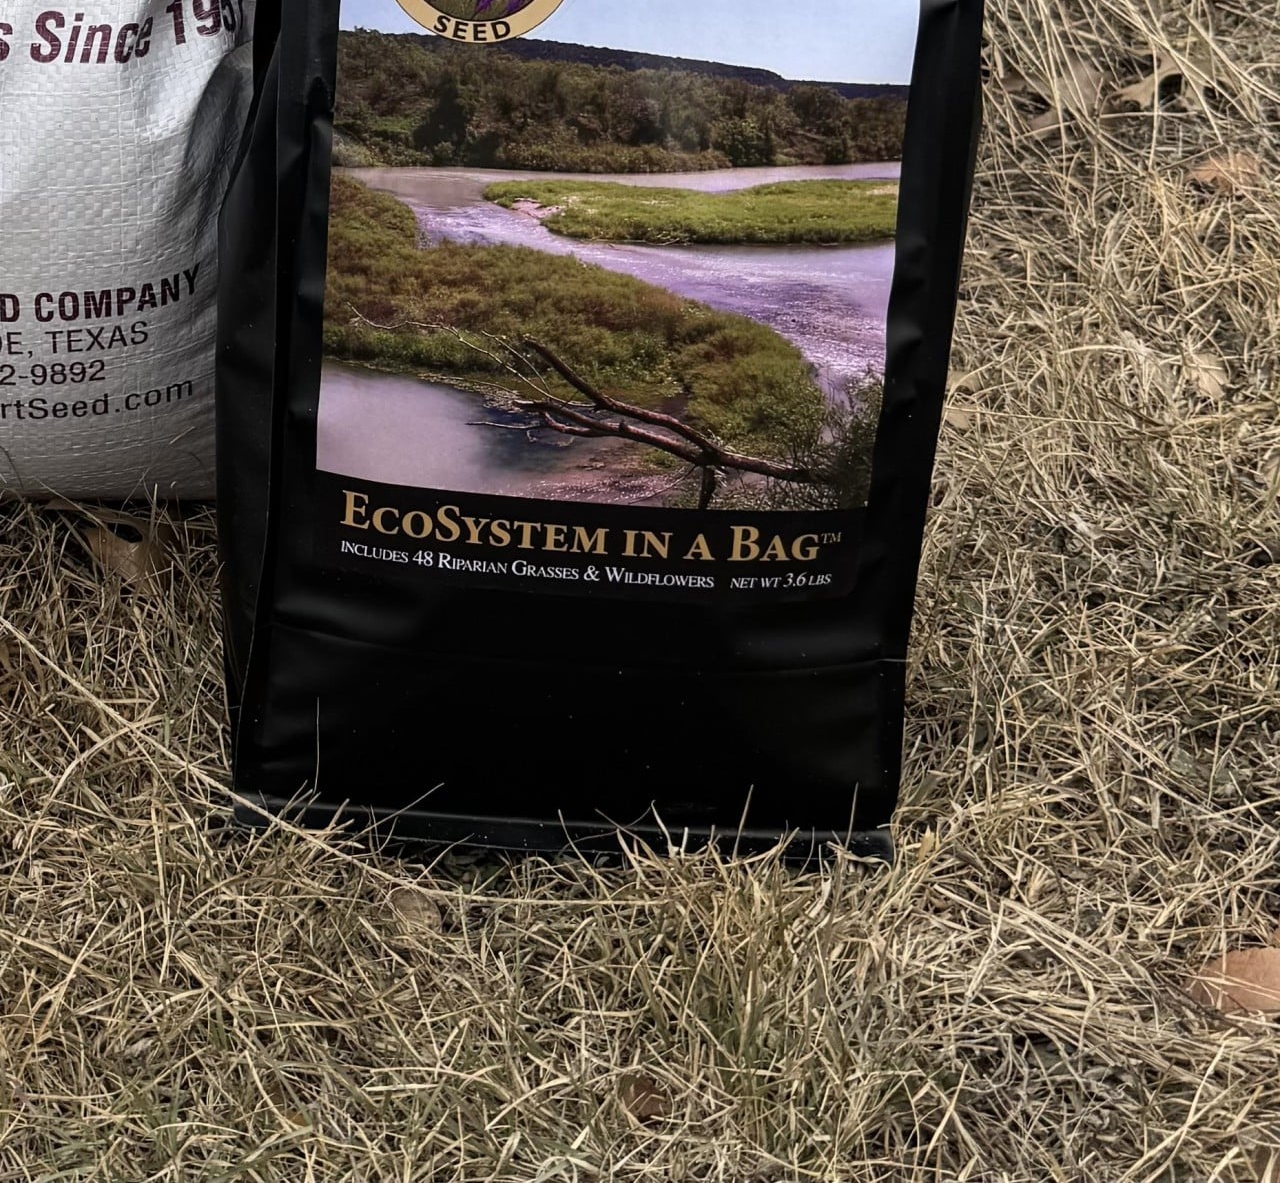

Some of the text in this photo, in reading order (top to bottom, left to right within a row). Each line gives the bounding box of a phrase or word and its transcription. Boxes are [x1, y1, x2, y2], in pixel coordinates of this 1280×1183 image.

[30, 10, 152, 65] Since
[433, 13, 512, 43] SEED
[34, 263, 201, 323] COMPANY
[44, 320, 150, 354] TEXAS
[622, 528, 674, 559] IN
[683, 533, 715, 561] A
[340, 540, 715, 588] INCLUDES 48 RIPARIAN GRASSES & WILDFLOWERS
[730, 572, 832, 589] NET WT 3.6 LBS
